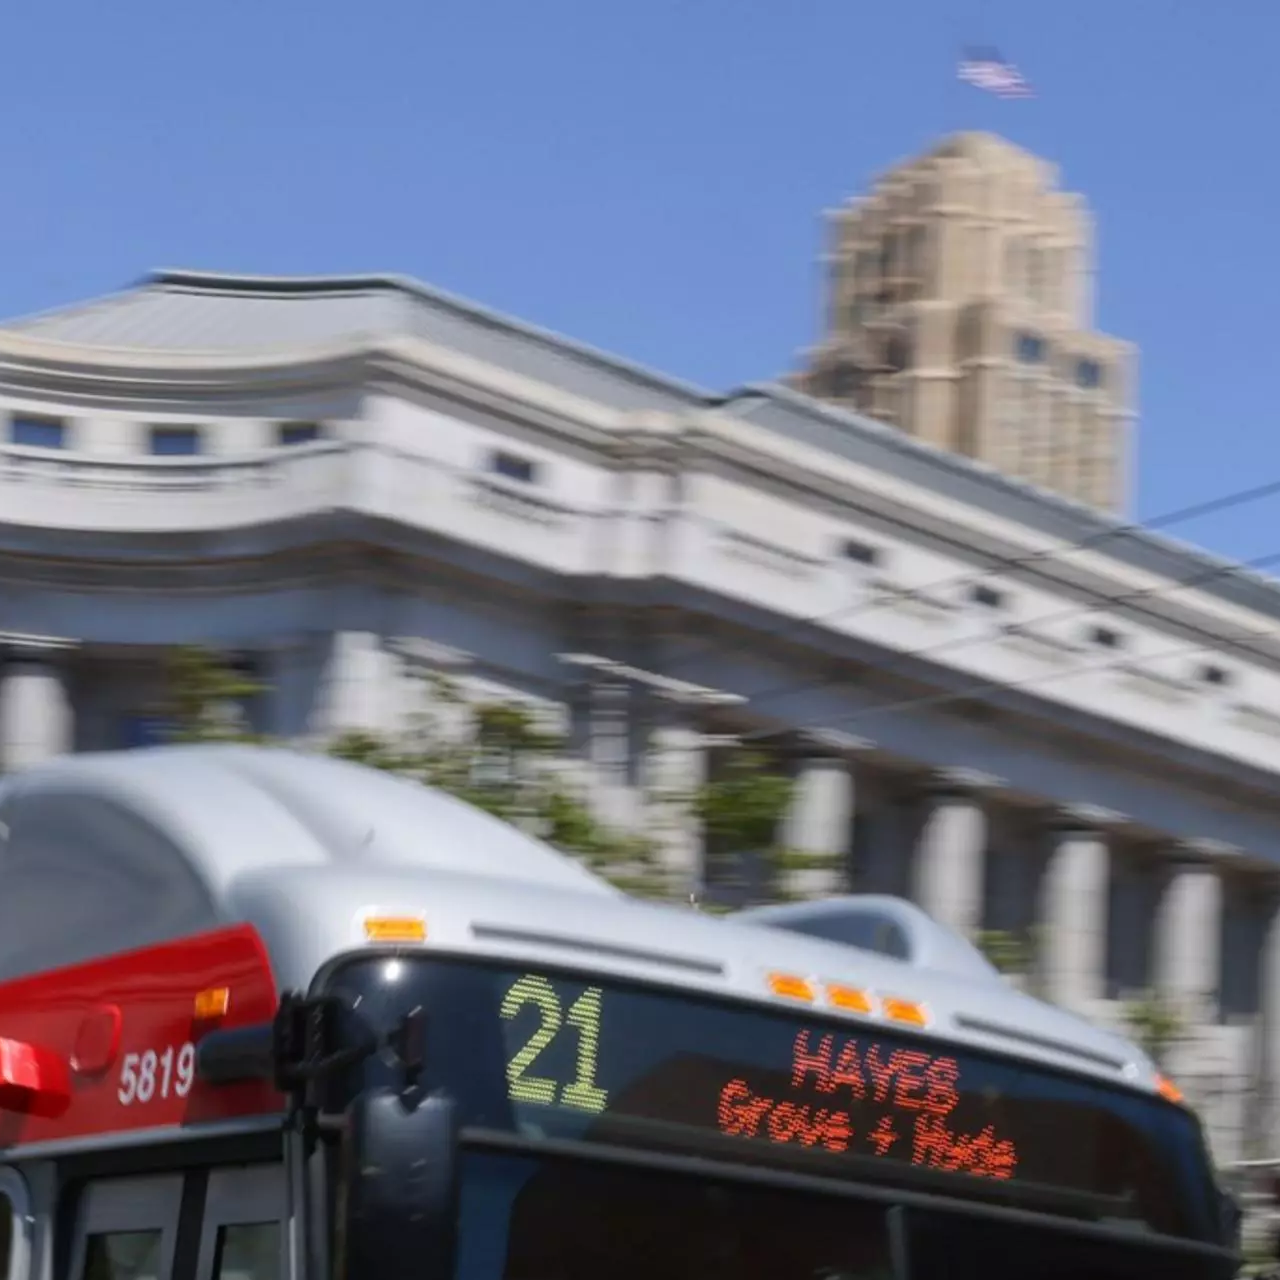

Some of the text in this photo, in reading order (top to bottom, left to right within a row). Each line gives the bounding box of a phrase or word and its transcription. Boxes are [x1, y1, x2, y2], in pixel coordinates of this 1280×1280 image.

[119, 1042, 195, 1105] 5819
[499, 974, 608, 1113] 21
[791, 1028, 961, 1116] HAYES
[718, 1077, 854, 1153] Grove
